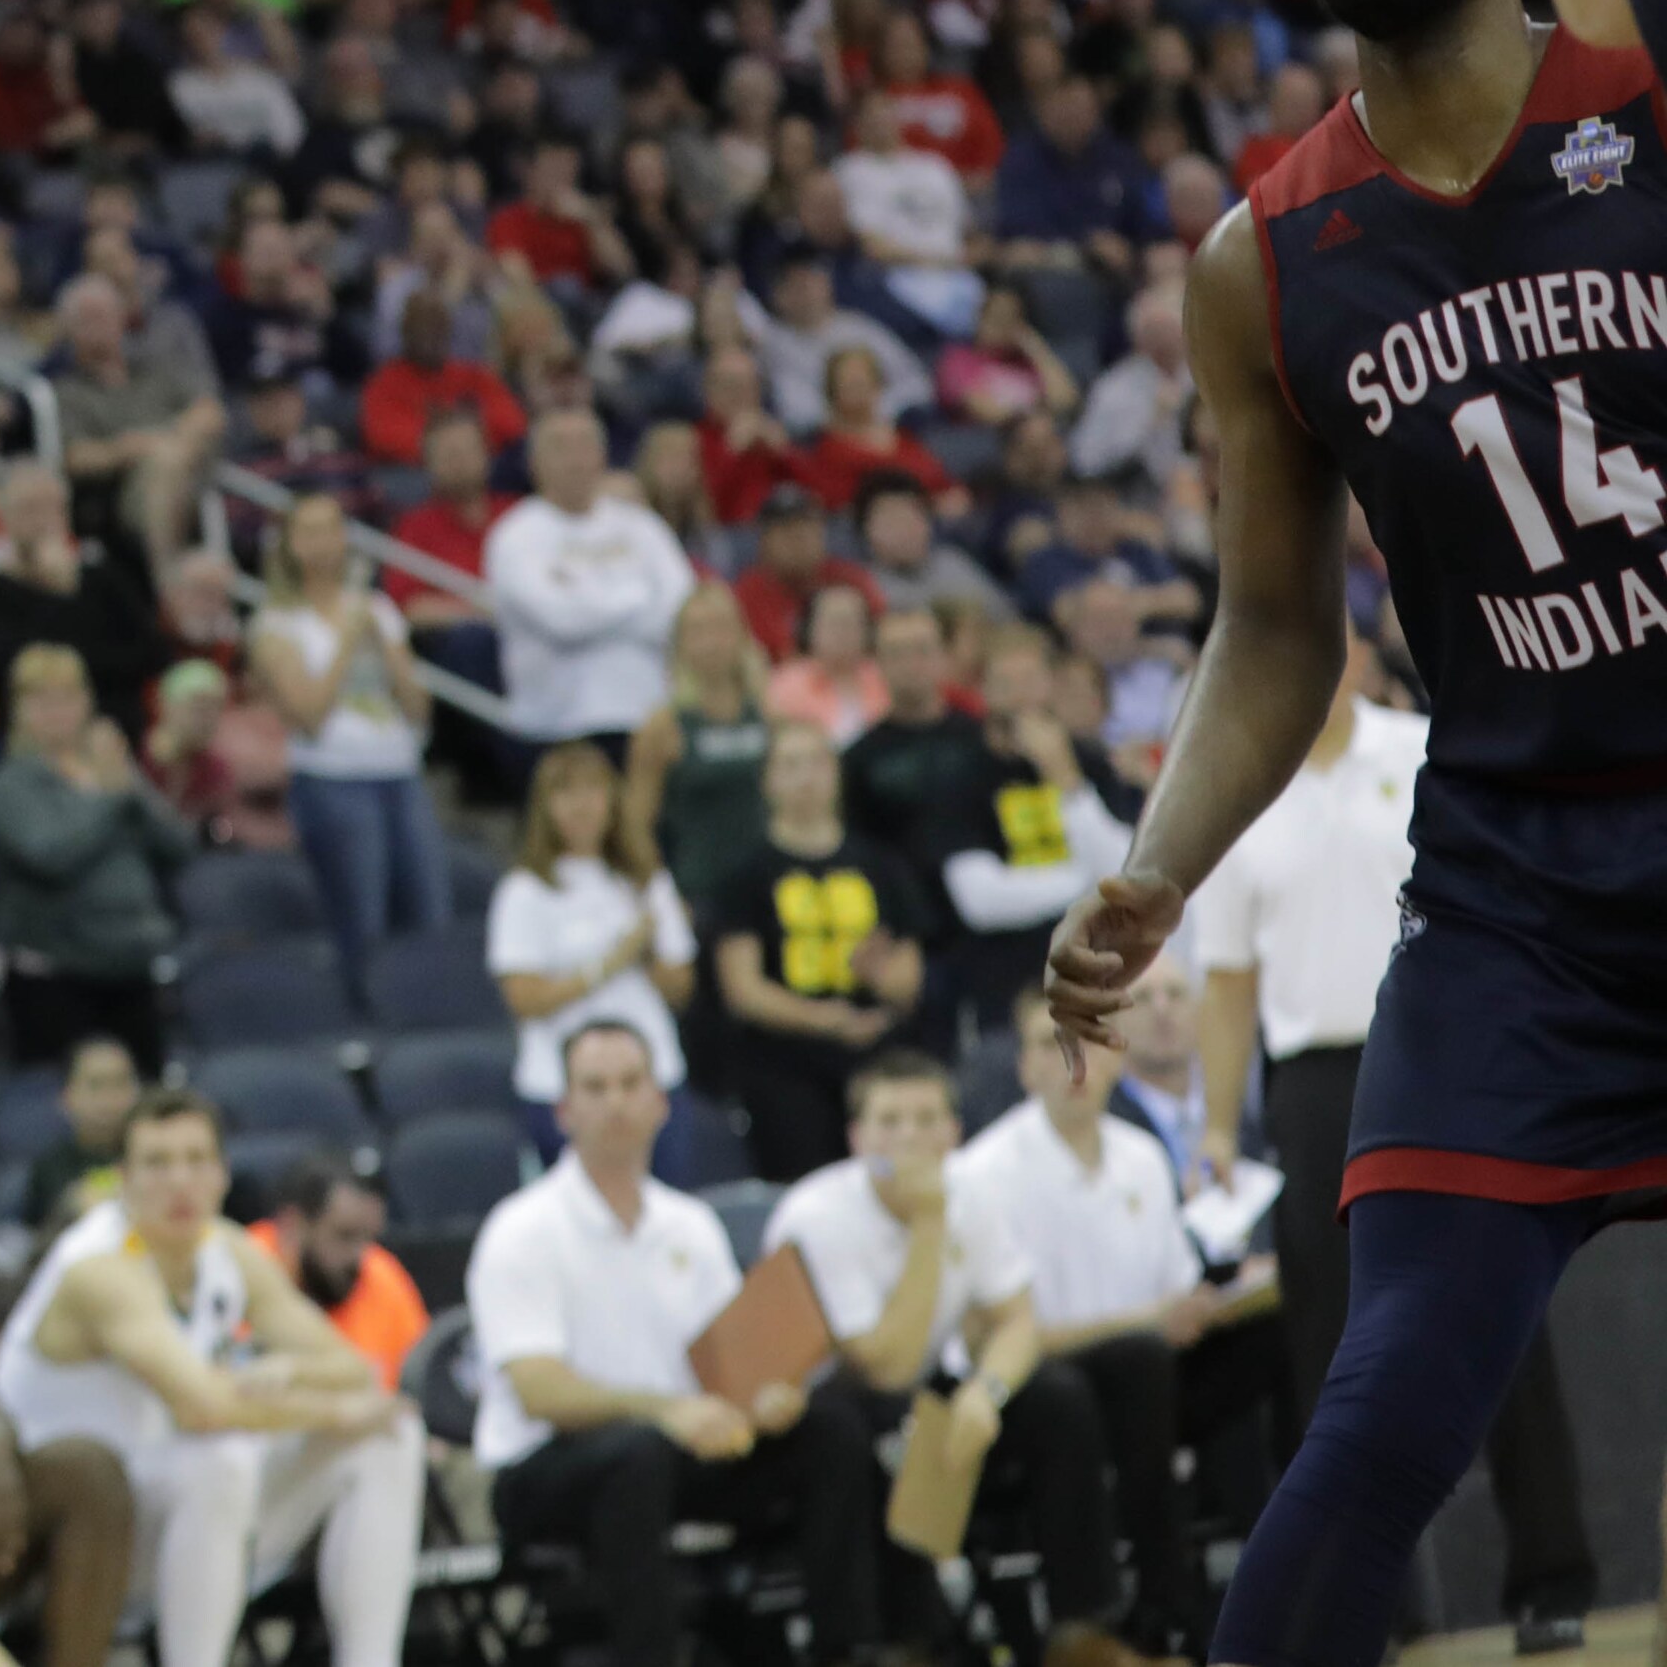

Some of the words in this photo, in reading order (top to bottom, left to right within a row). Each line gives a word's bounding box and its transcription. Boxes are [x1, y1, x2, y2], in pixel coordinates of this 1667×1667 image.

[1347, 268, 1667, 438] SOUTHERN
[1450, 374, 1667, 574] 14
[1475, 548, 1667, 673] INDIA
